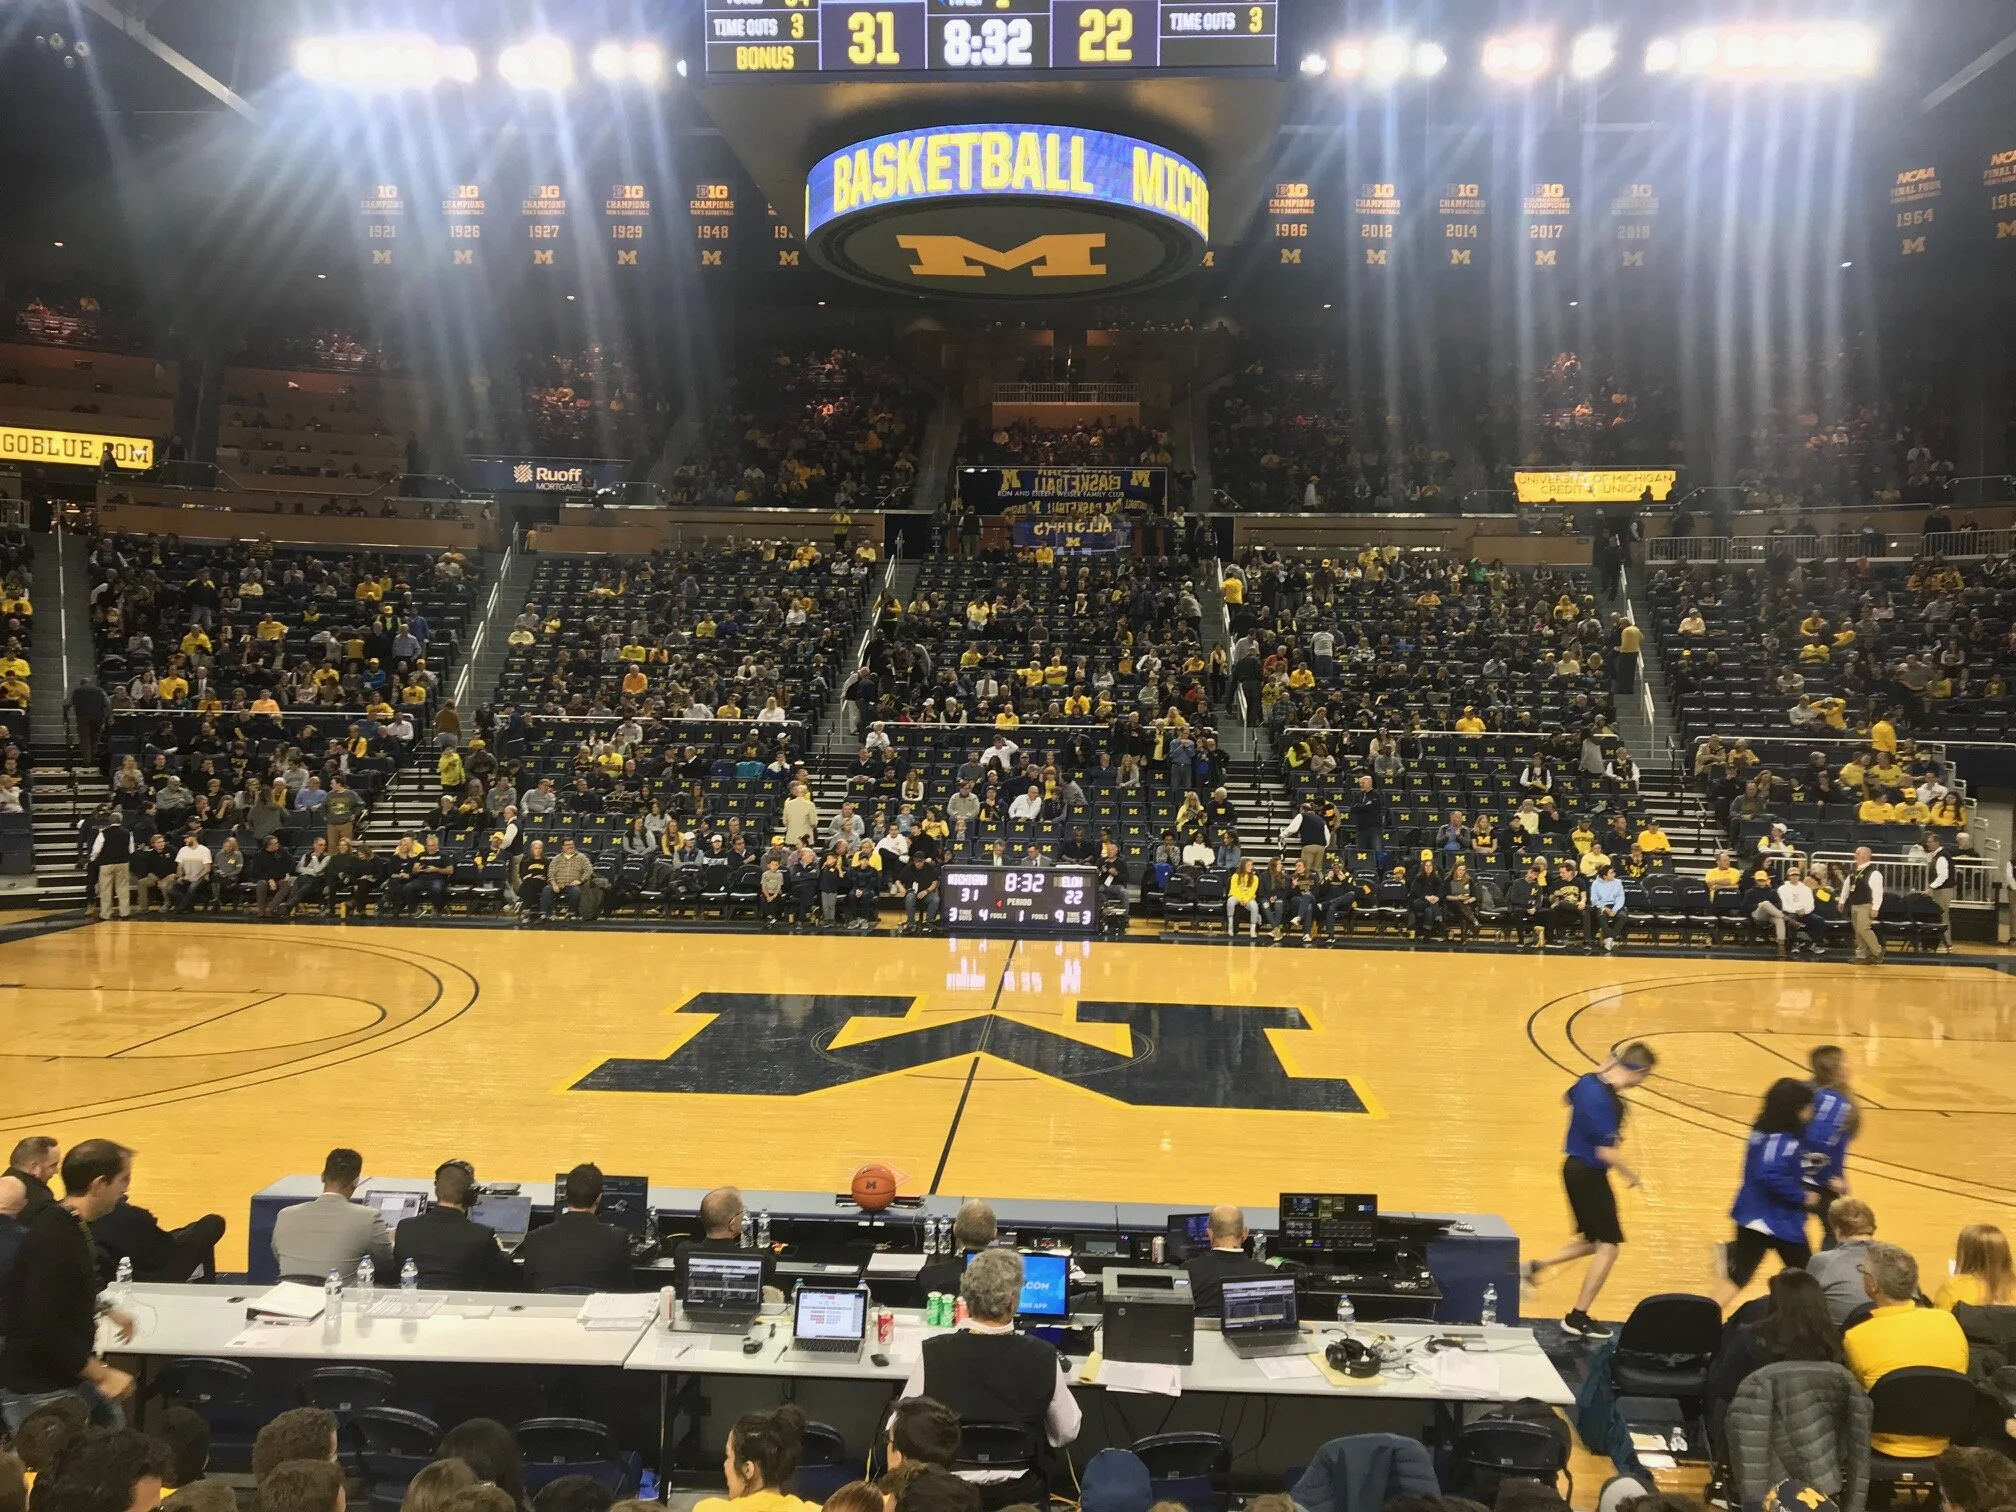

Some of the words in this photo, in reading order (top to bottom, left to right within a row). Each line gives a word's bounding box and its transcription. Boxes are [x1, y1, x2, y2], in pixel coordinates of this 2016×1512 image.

[714, 19, 745, 37] TIME
[747, 18, 778, 37] OUTS
[791, 13, 804, 39] 3
[1169, 12, 1202, 31] TIME
[1203, 12, 1236, 30] OUTS
[1249, 6, 1263, 33] 3
[848, 11, 900, 65] 31
[1079, 8, 1133, 62] 22
[944, 18, 1032, 66] 8:32
[736, 46, 794, 70] BONUS
[833, 131, 1094, 214] BASKETBALL
[522, 200, 566, 208] CHAMPIONS
[606, 200, 650, 209] CHAMPIONS
[690, 200, 734, 209] CHAMPIONS
[1269, 199, 1315, 208] CHAMPIONS
[1356, 199, 1401, 208] CHAMPIONS
[1896, 208, 1934, 228] 1964
[368, 225, 396, 238] 1921
[450, 225, 480, 238] 1926
[528, 225, 560, 238] 1927
[612, 226, 643, 238] 1929
[697, 226, 728, 238] 1948
[1276, 224, 1308, 237] 1986
[1361, 224, 1392, 238] 2012
[1446, 224, 1478, 238] 2014
[1530, 225, 1564, 238] 2017
[536, 467, 582, 482] Ruoff
[1612, 473, 1673, 483] MICHIGAN
[1541, 484, 1584, 494] CREDIT
[1603, 484, 1643, 494] UNION
[948, 873, 988, 886] MICHIGAN
[1004, 872, 1045, 893] 8:32
[1061, 876, 1084, 888] ELON
[960, 888, 979, 902] 31
[1064, 890, 1084, 904] 22
[1006, 898, 1032, 906] PERIOD
[949, 907, 958, 922] 3
[978, 909, 988, 922] 4
[1018, 910, 1024, 922] 1
[1054, 910, 1064, 923] 9
[1082, 910, 1091, 925] 3
